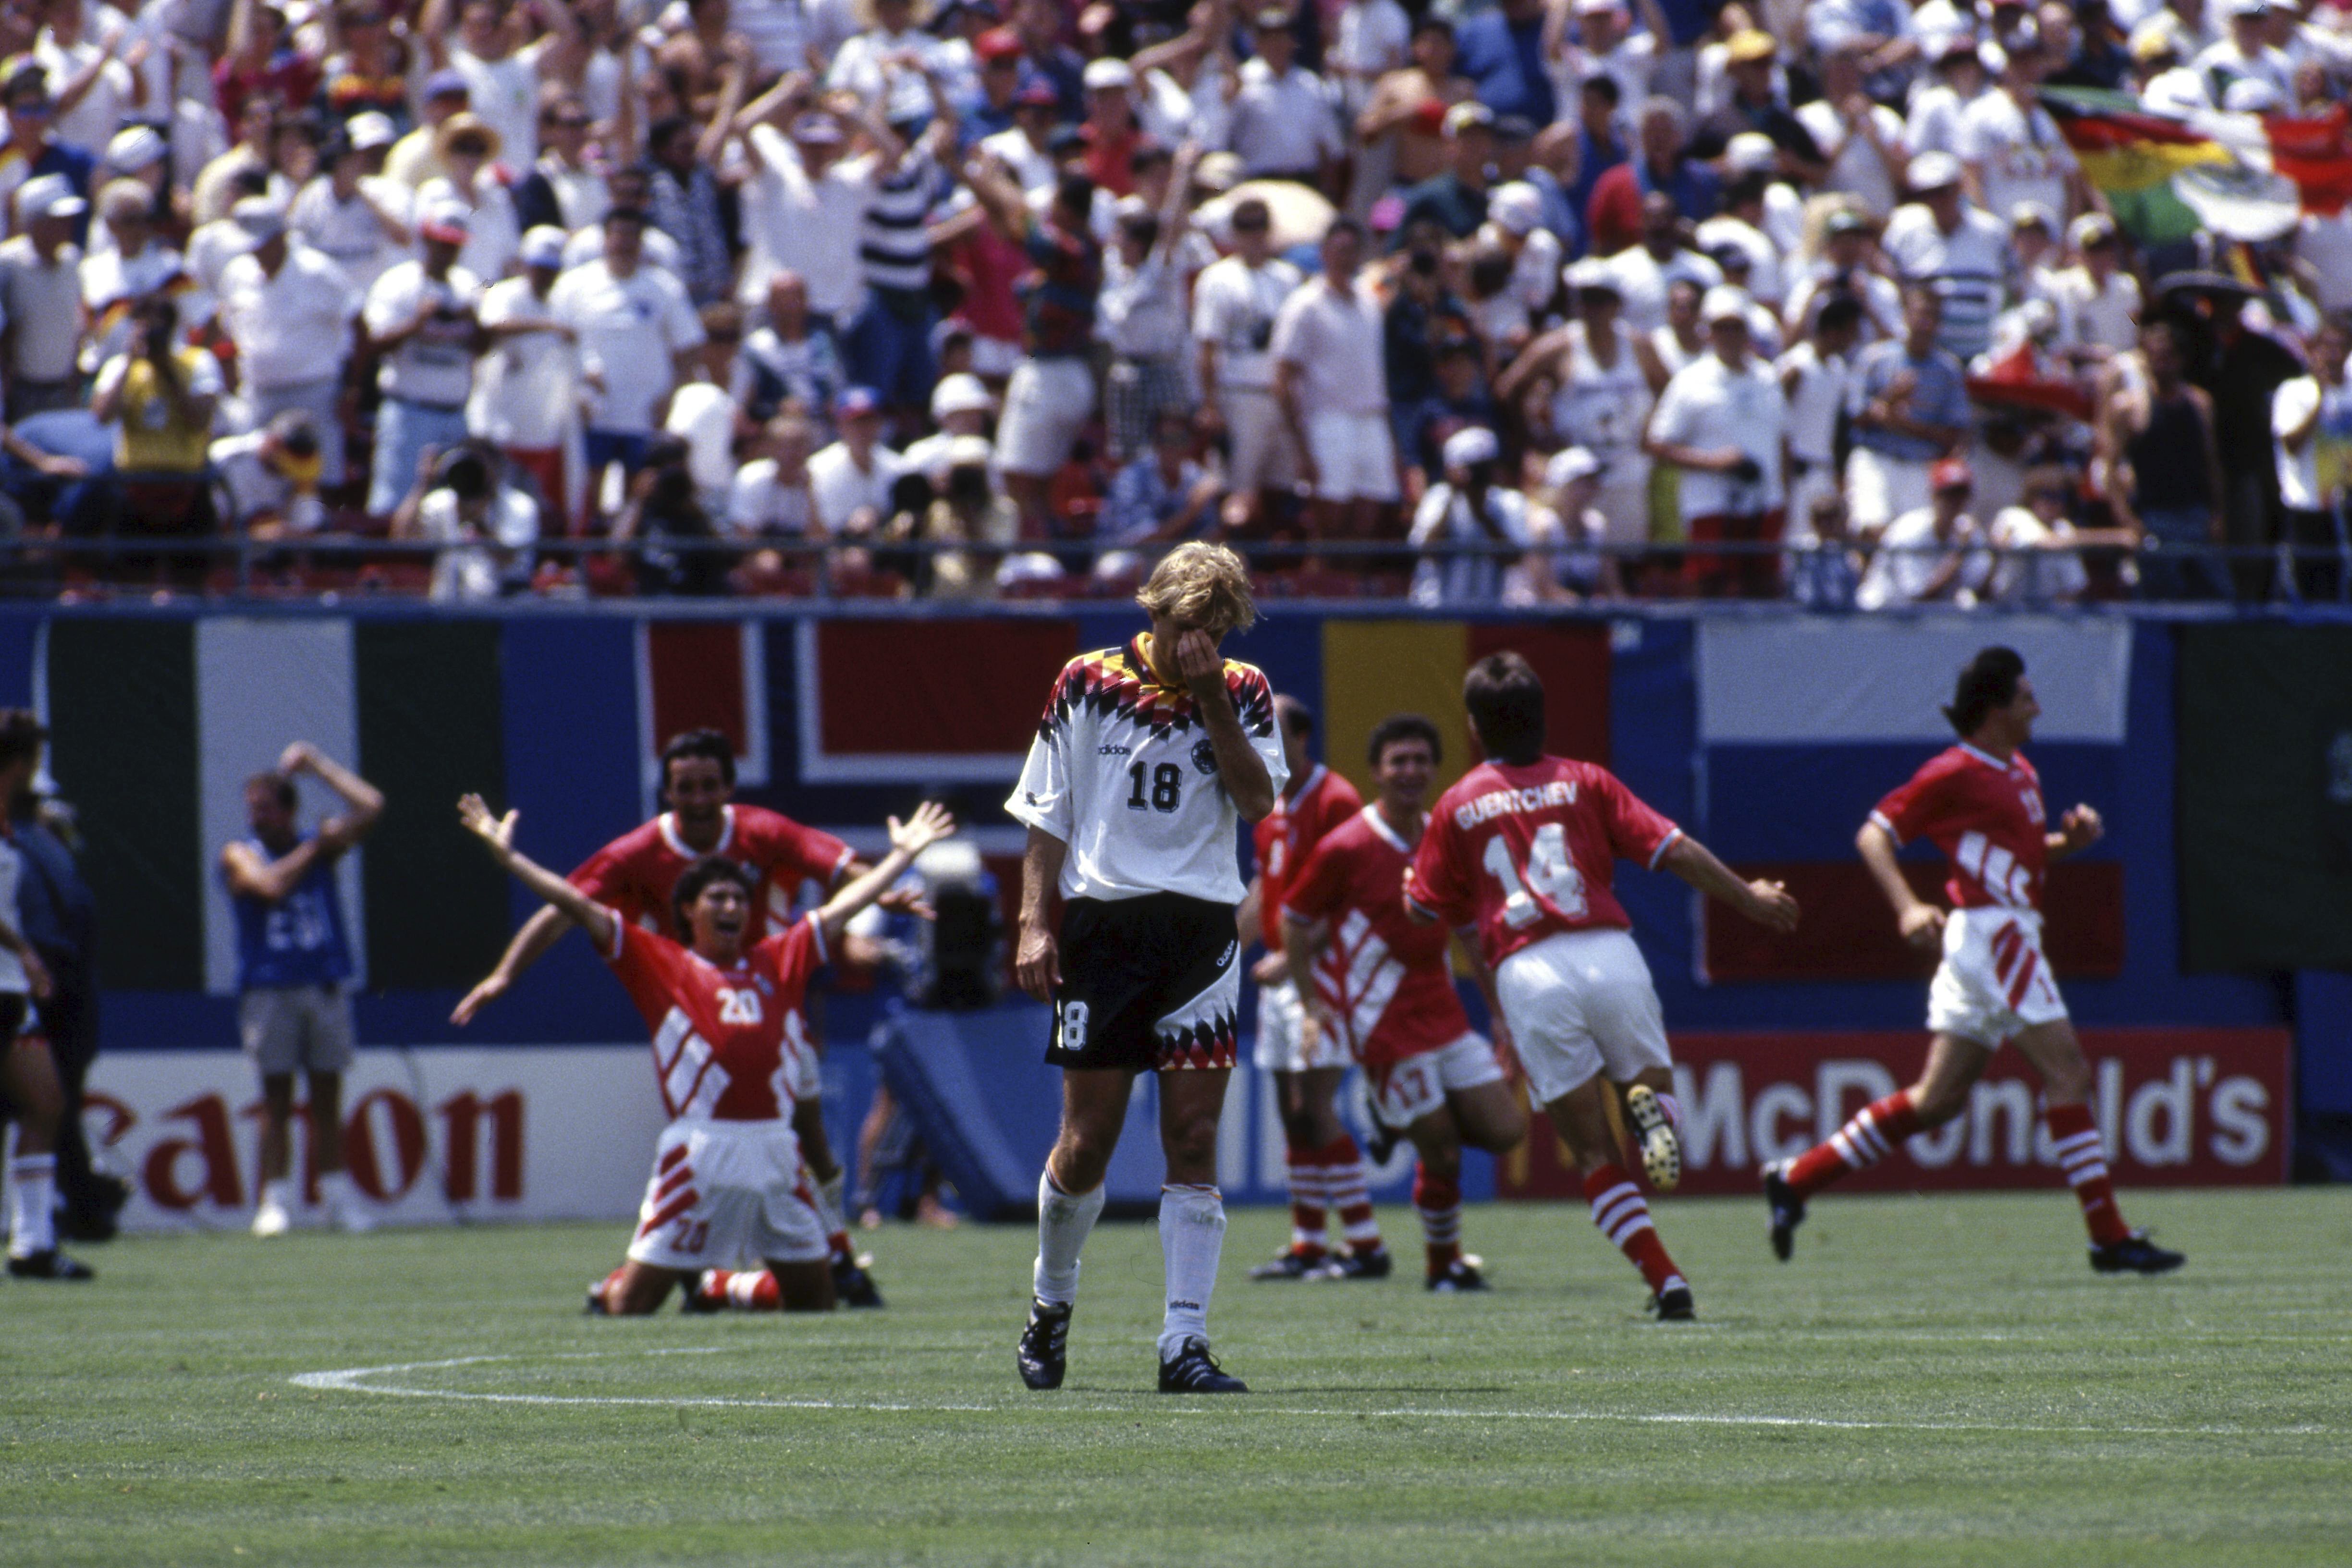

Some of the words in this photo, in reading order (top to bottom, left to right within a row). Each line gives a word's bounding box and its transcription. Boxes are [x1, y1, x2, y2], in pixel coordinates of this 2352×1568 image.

[1127, 761, 1182, 813] 18
[1455, 780, 1578, 830] GUENTCHEV
[1482, 822, 1588, 930] 14
[715, 988, 762, 1024] 20
[1392, 1068, 1430, 1110] 17
[1672, 1058, 2269, 1168] McDnld's
[671, 1218, 710, 1253] 20
